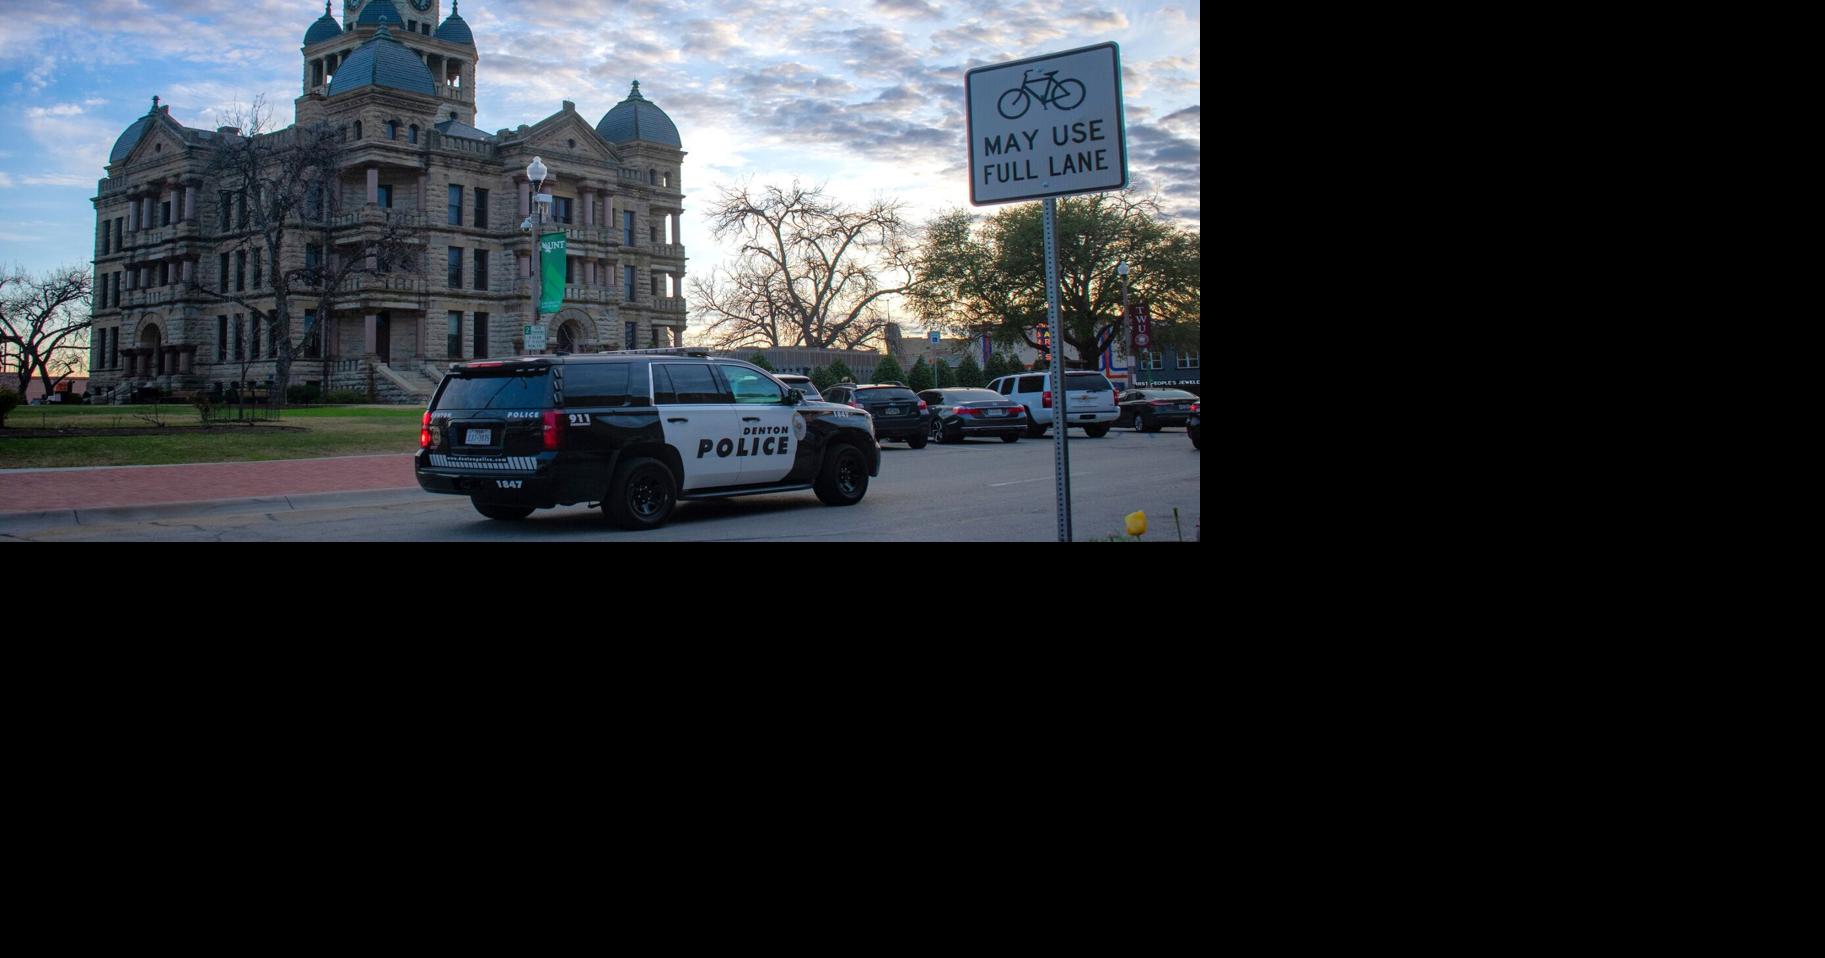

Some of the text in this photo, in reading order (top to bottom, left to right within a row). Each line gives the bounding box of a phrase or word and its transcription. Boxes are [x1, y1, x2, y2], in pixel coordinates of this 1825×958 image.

[984, 119, 1105, 157] MAY USE
[984, 149, 1109, 185] FULL LANE
[548, 240, 565, 250] UNT
[1136, 307, 1146, 333] TWU
[569, 413, 591, 424] 911
[743, 426, 789, 435] DENTON
[696, 436, 790, 459] POLICE
[496, 480, 523, 489] 1847
